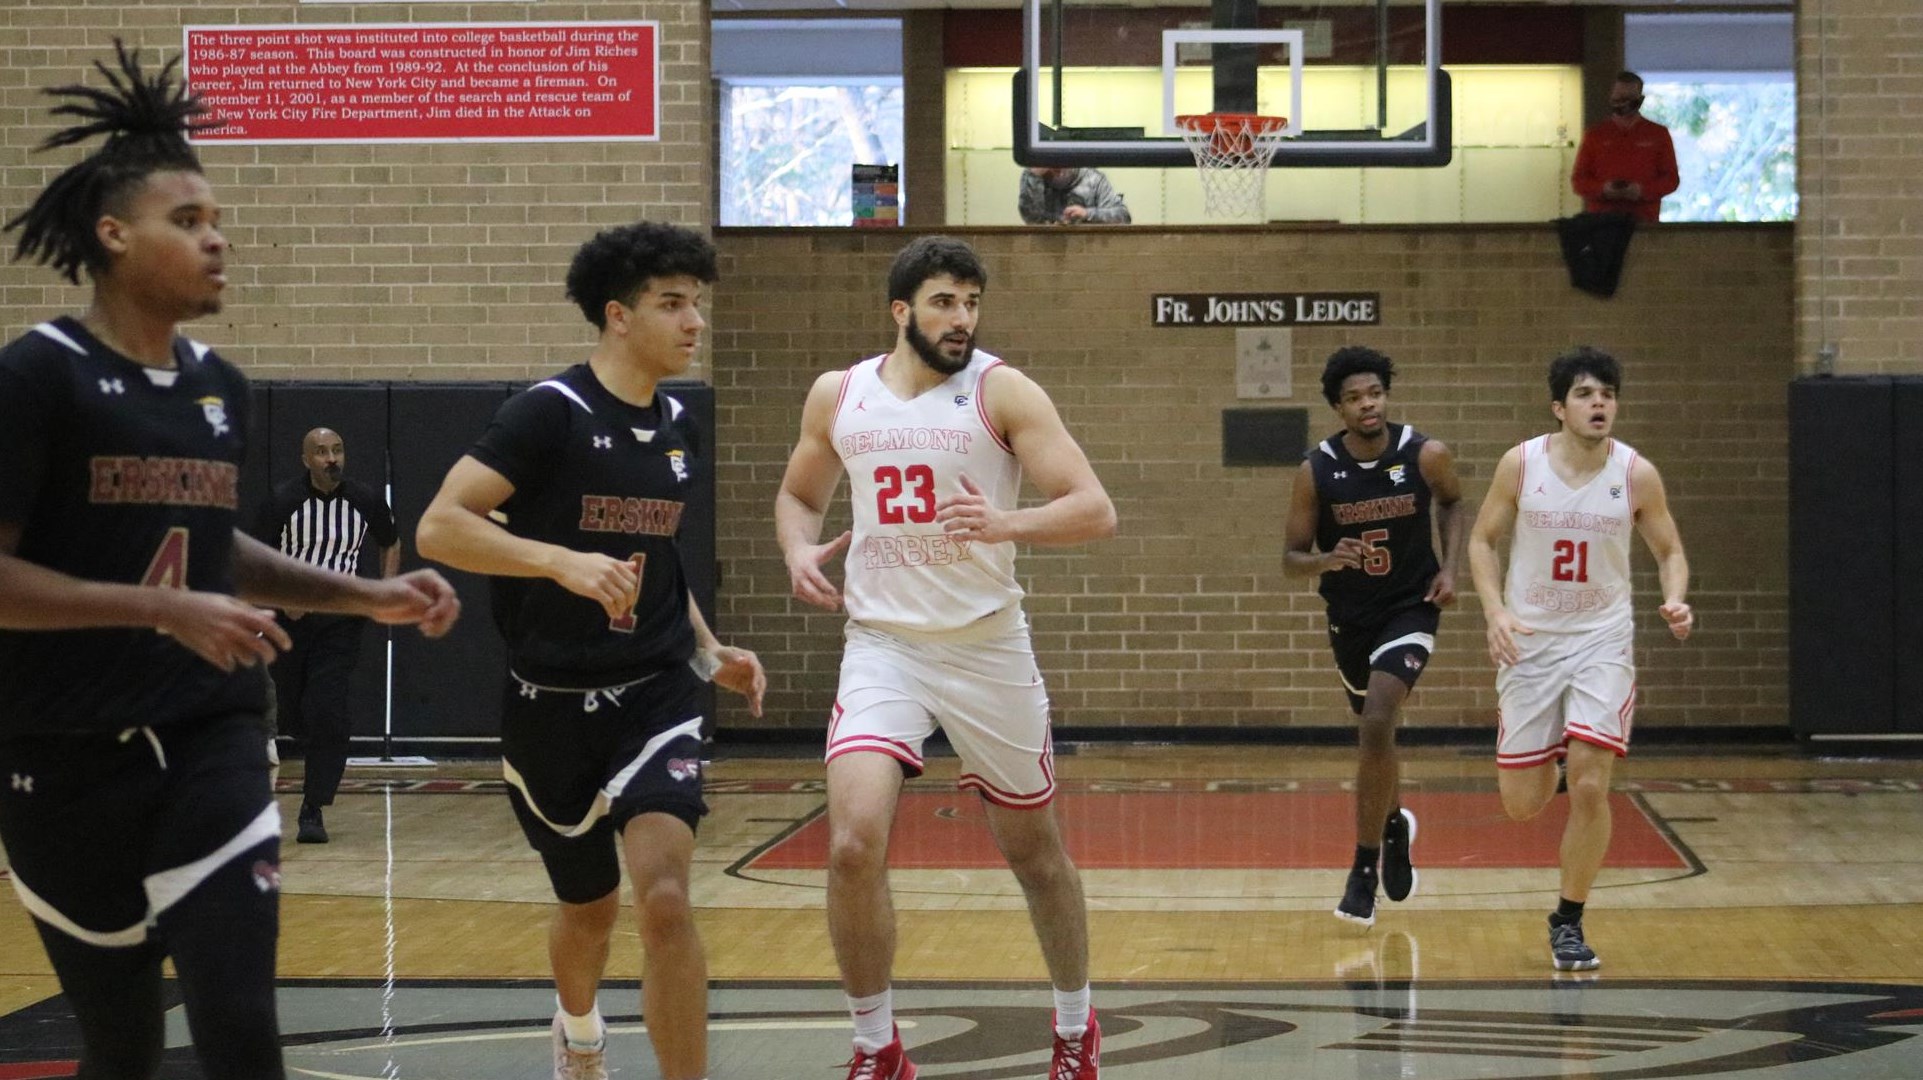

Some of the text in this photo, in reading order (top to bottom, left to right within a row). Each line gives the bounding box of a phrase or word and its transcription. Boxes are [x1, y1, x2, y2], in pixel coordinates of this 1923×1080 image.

[191, 30, 639, 48] The three point shot was instituted into college basketball during the
[194, 45, 638, 60] 1986-87 season. This board was constructed in honor of Jim Riches
[191, 60, 608, 77] who played at the Abbey from 1989-92. At the conclusion of his
[191, 75, 617, 91] career, Jim returned to New York City and became a fireman. On
[197, 89, 632, 107] eptember 11, 2001, as a member of the search and rescue team of
[216, 107, 244, 119] New
[247, 107, 278, 119] York
[281, 107, 308, 122] City
[312, 107, 337, 118] Fire
[341, 106, 423, 121] Department,
[426, 106, 451, 117] Jim
[455, 106, 483, 117] died
[487, 105, 500, 117] in
[504, 105, 525, 117] the
[528, 105, 571, 117] Attack
[574, 108, 591, 116] on
[1155, 297, 1194, 322] FR.
[1294, 296, 1375, 322] LEDGE
[840, 428, 971, 460] BELMONT
[873, 464, 937, 525] 23
[1331, 493, 1416, 525] ERSKINE
[579, 495, 685, 537] ERSKIN
[1524, 510, 1621, 536] BELMONT
[863, 534, 973, 570] ABBEY
[1361, 528, 1391, 575] 5
[1552, 539, 1588, 582] 21
[608, 552, 646, 633] 1
